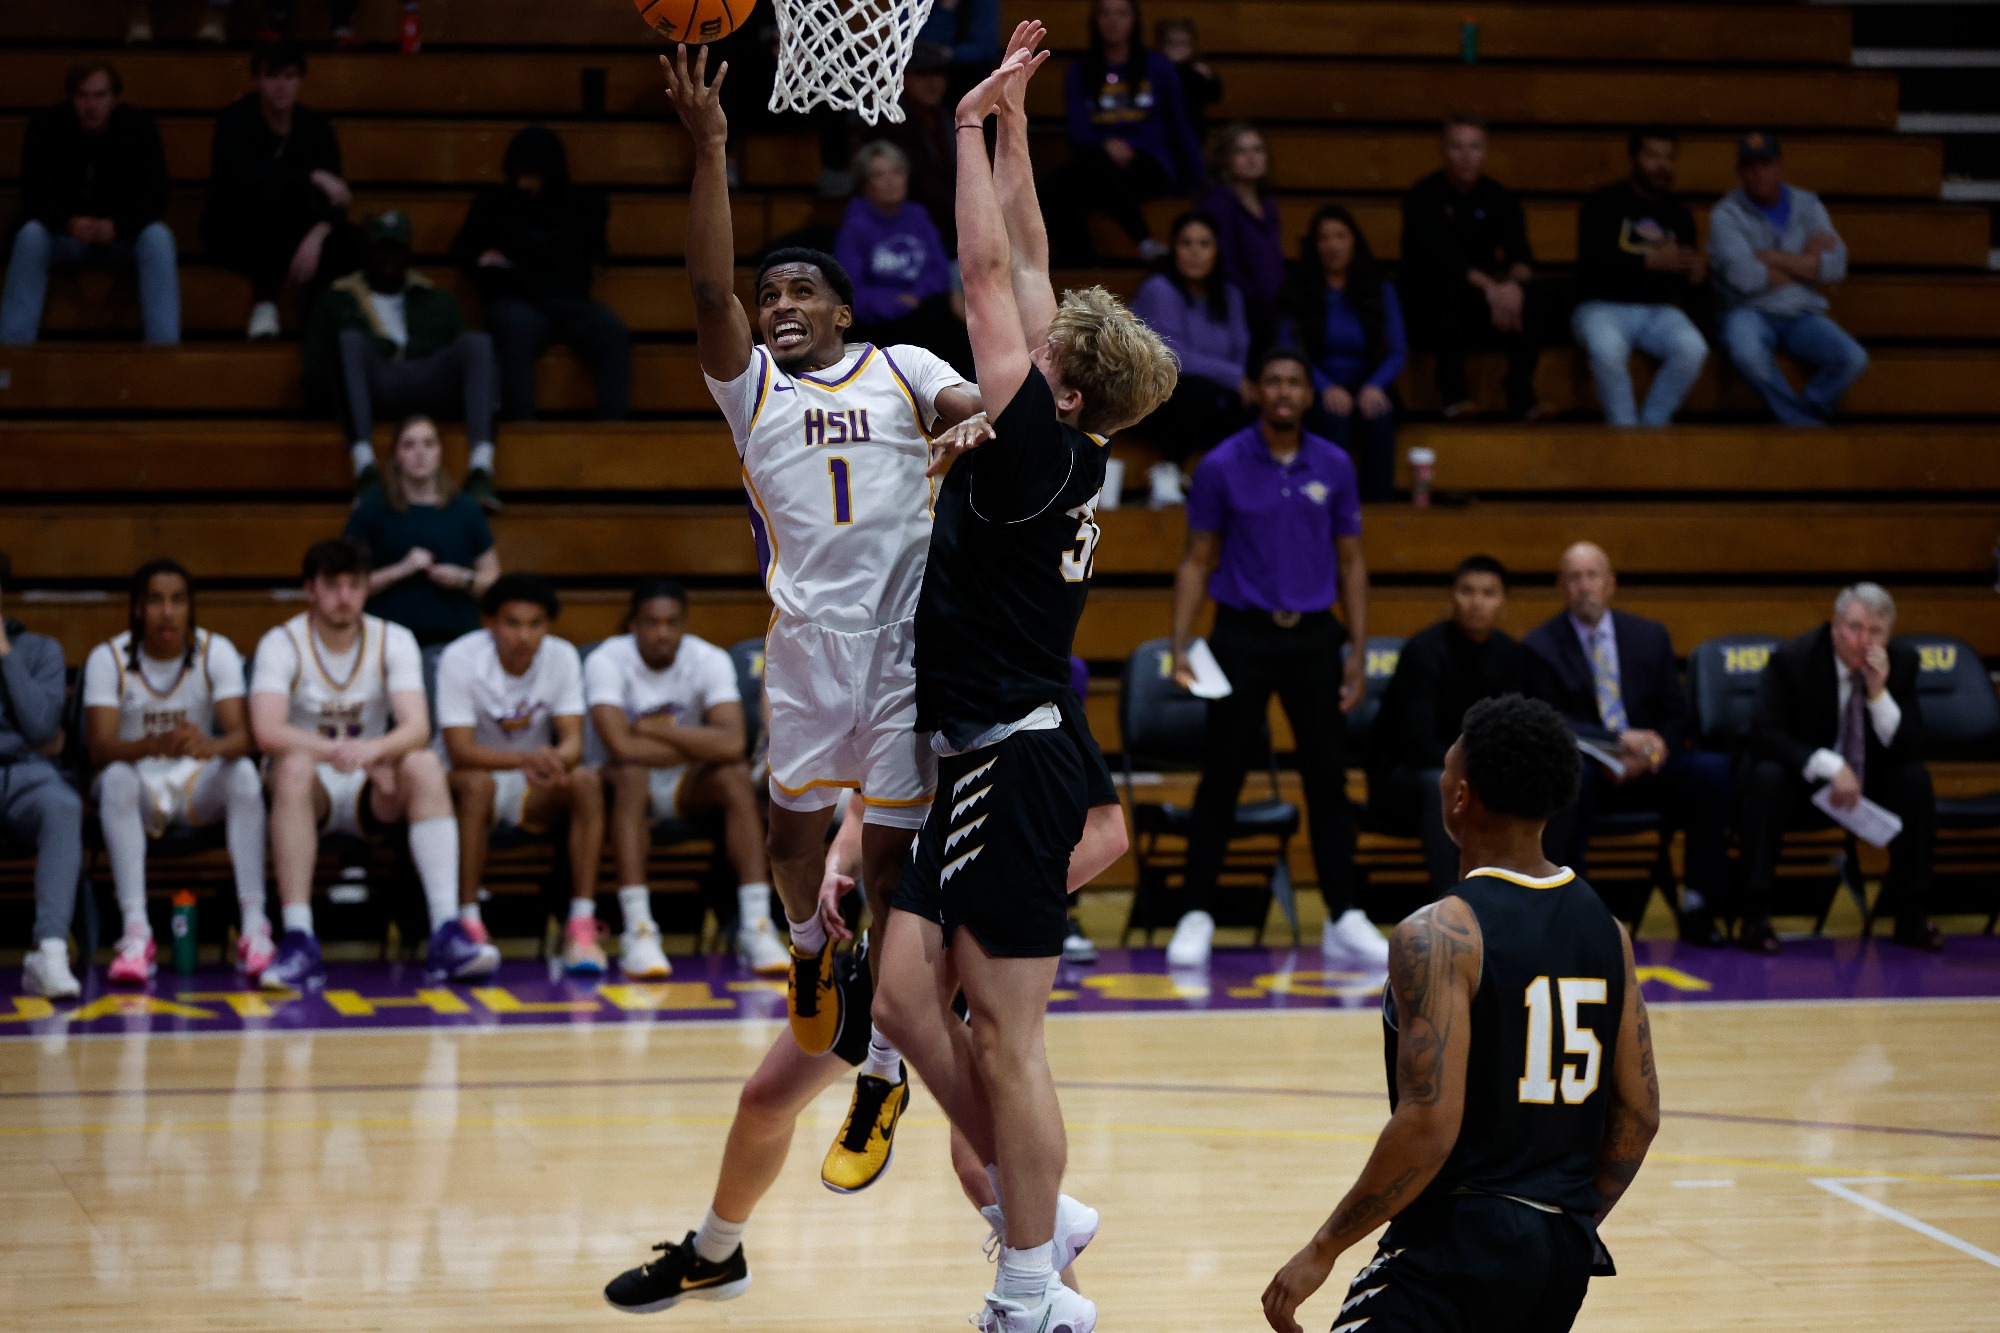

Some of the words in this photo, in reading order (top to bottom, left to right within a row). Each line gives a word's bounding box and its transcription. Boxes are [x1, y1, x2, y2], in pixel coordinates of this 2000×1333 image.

[804, 407, 870, 447] HSU
[828, 456, 853, 525] 1
[1059, 487, 1101, 583] 3
[1916, 645, 1957, 672] SU
[1518, 975, 1609, 1105] 15
